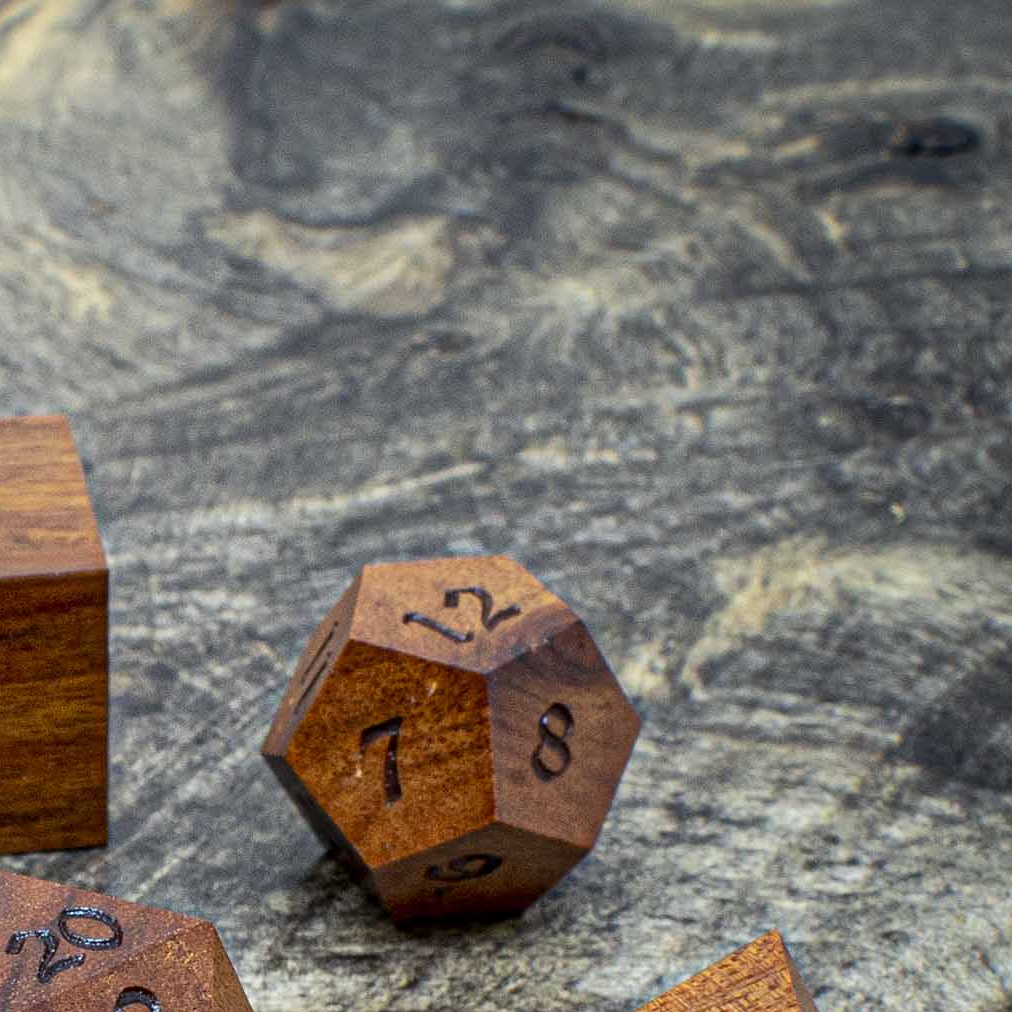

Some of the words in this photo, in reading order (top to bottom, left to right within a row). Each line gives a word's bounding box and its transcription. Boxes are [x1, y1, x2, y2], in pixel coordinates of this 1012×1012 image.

[402, 587, 521, 643] 12
[360, 716, 403, 807] 7
[531, 703, 574, 781] 8
[5, 906, 124, 984] 20
